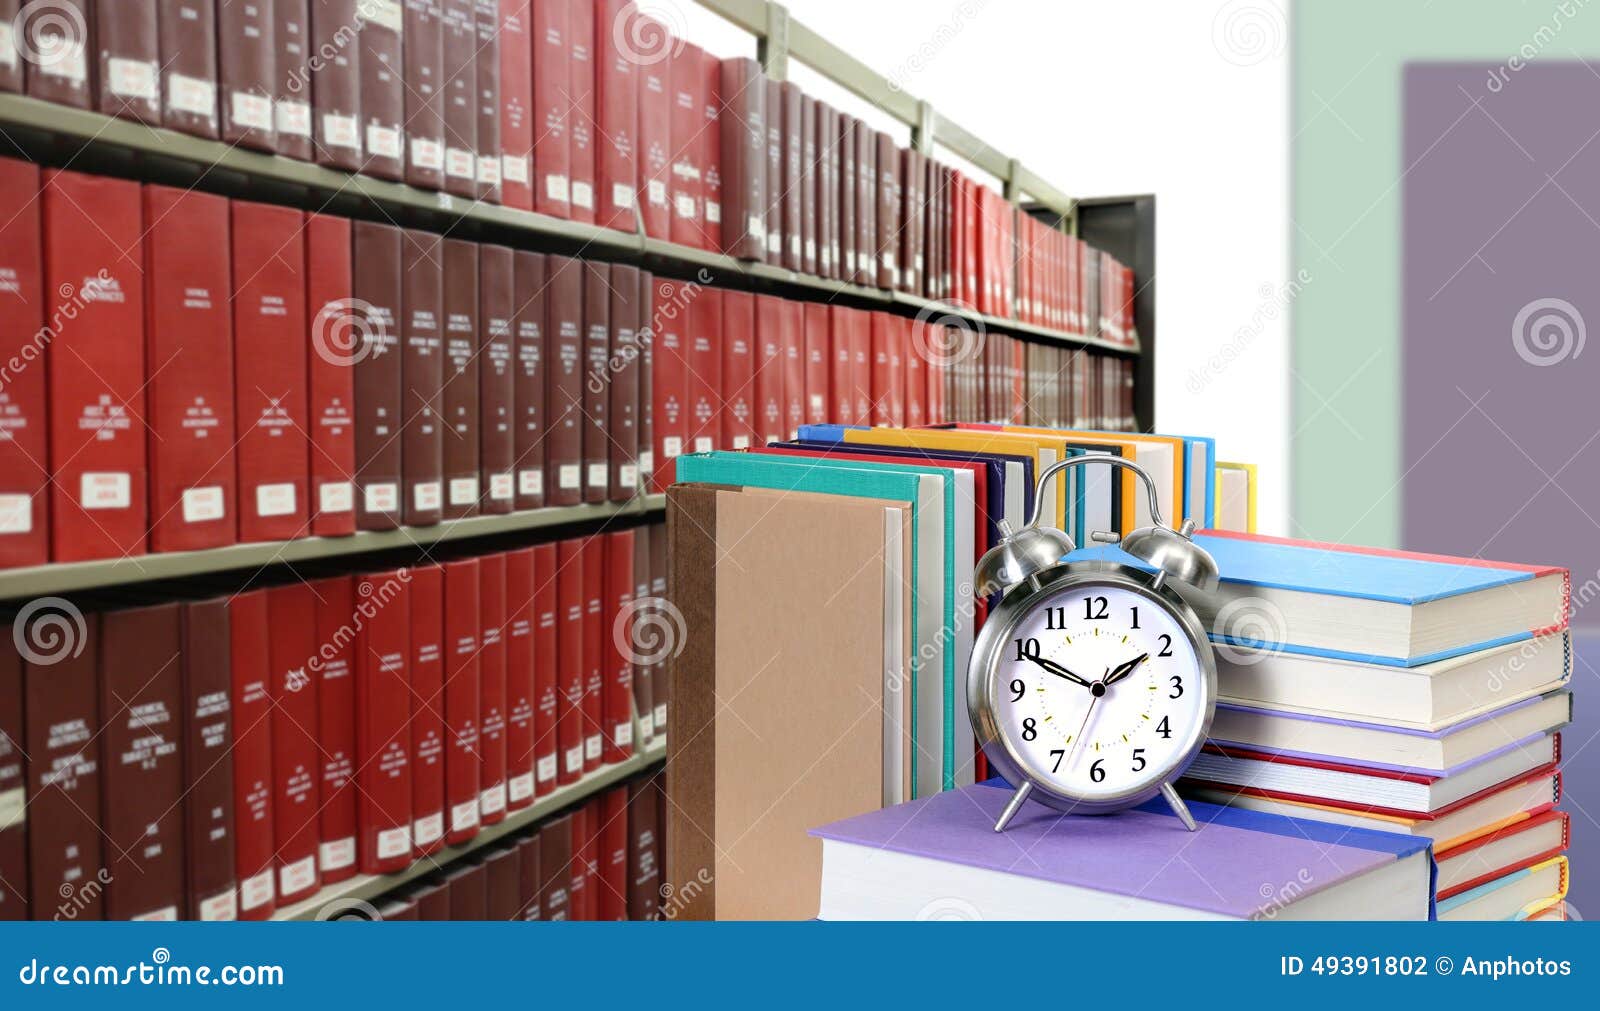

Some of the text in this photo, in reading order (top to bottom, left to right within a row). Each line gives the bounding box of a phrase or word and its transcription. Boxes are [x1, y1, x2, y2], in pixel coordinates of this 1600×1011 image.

[1045, 606, 1068, 630] 11
[1083, 596, 1110, 620] 12
[1130, 606, 1141, 629] 1
[1014, 638, 1041, 661] 10
[1158, 634, 1173, 657] 2
[1009, 679, 1026, 703] 9
[1169, 675, 1184, 699] 3
[1021, 717, 1037, 741] 8
[1155, 715, 1172, 739] 4
[1049, 749, 1065, 774] 7
[1089, 758, 1106, 783] 6
[1132, 748, 1146, 772] 5
